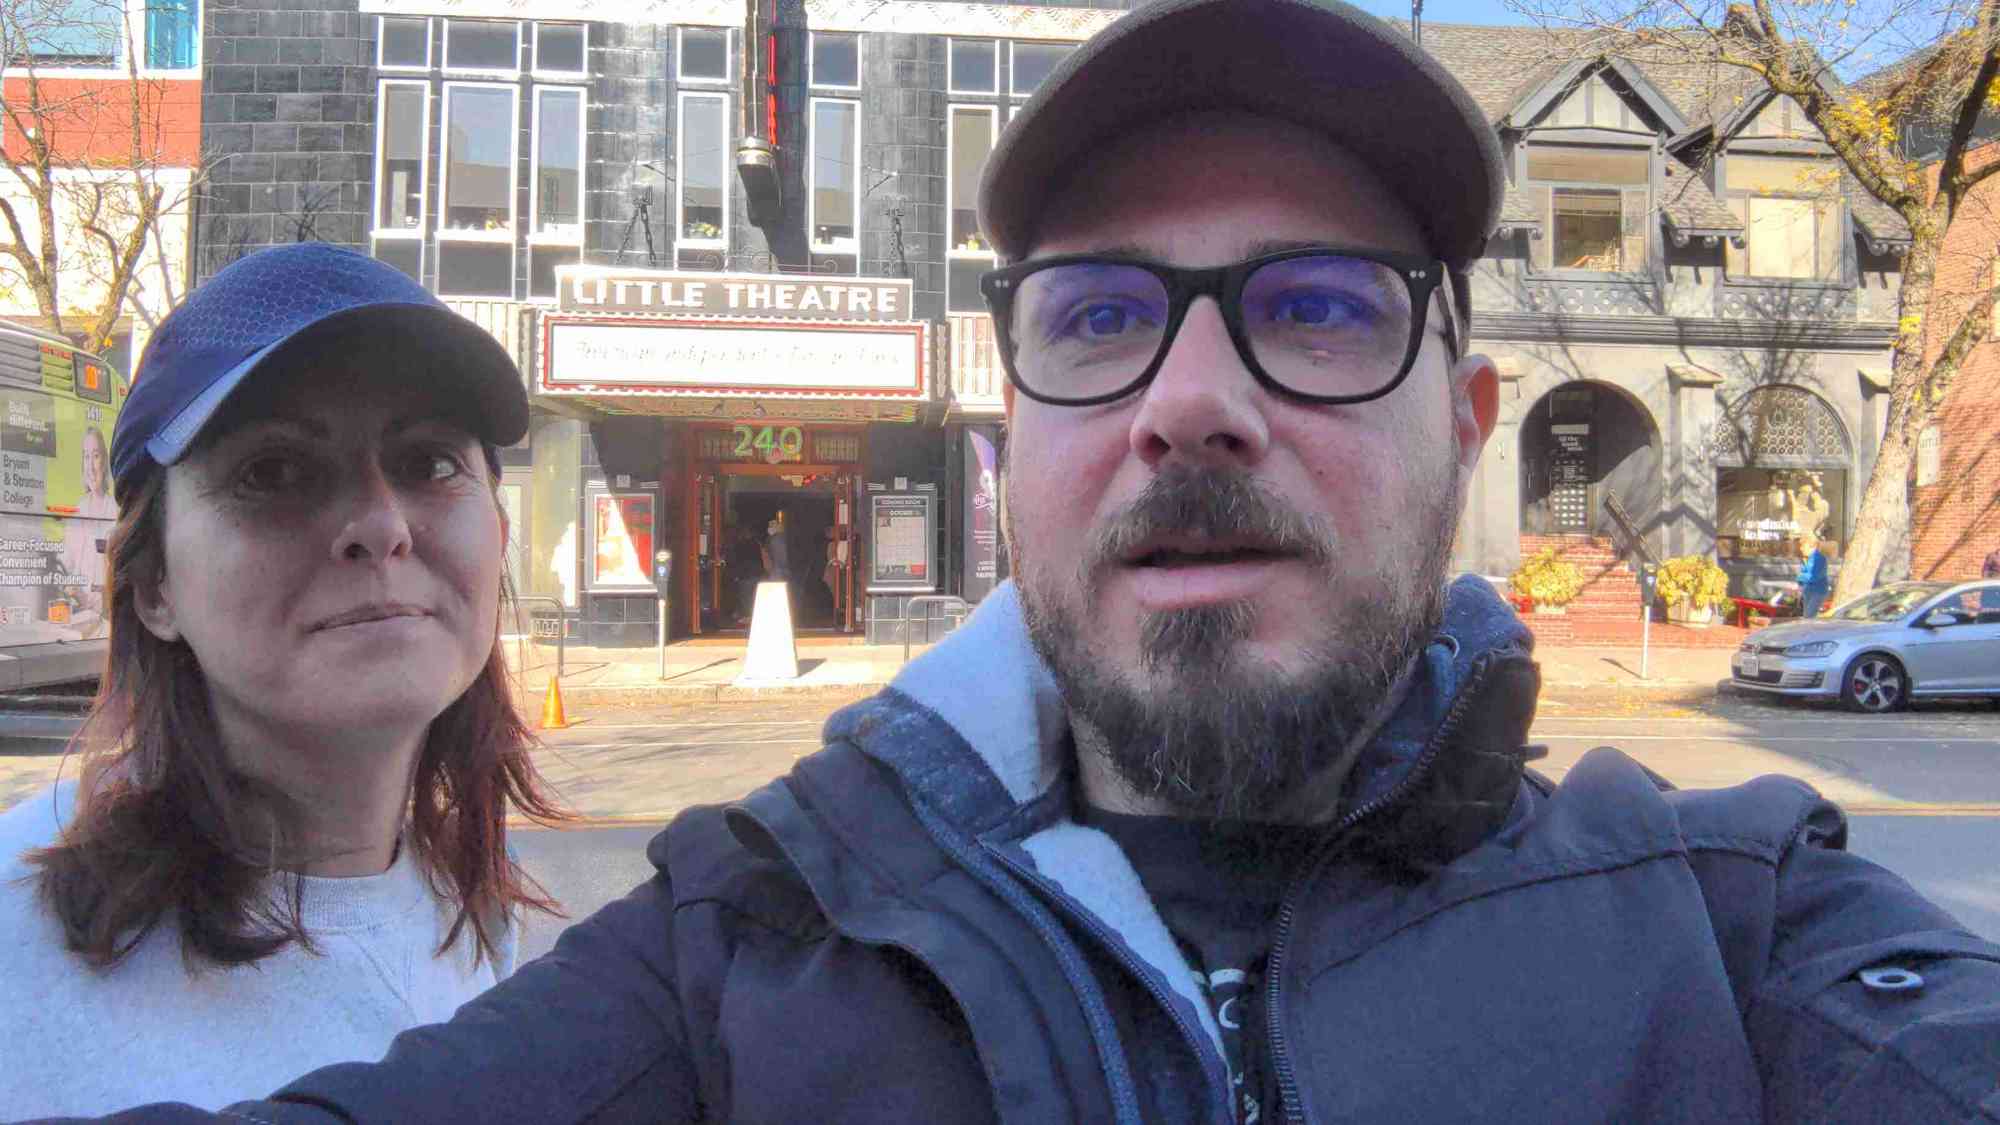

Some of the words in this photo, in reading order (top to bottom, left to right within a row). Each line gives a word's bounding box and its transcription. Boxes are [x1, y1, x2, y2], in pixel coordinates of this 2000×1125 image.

[573, 276, 707, 307] LITTLE
[721, 281, 899, 313] THEATRE
[735, 425, 803, 457] 240
[43, 572, 53, 585] of
